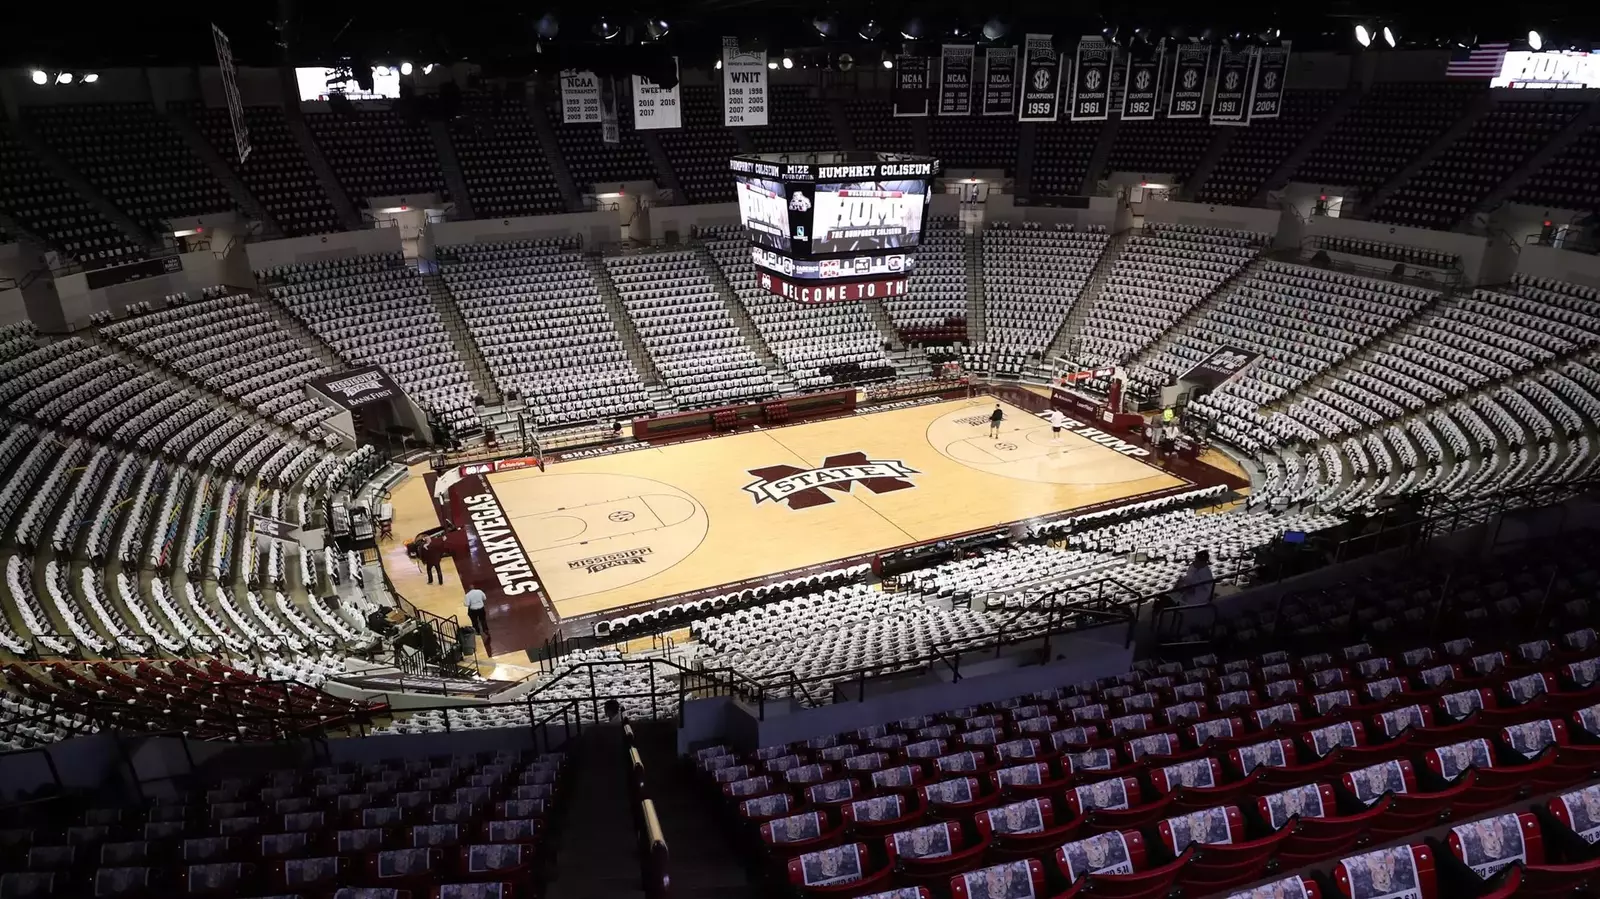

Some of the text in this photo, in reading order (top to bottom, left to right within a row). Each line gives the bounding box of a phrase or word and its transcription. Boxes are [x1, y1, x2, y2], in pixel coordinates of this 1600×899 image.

[567, 78, 594, 88] NCAA
[730, 72, 761, 83] WNIT
[901, 74, 923, 83] NCAA
[946, 74, 967, 83] NCAA
[990, 74, 1010, 83] NCAA
[1034, 69, 1050, 90] SEC
[1086, 69, 1101, 90] SEC
[1136, 70, 1150, 90] SEC
[1183, 69, 1198, 89] SEC
[1225, 71, 1239, 90] SEC
[1263, 71, 1277, 90] SEC
[638, 99, 655, 107] 2010
[1028, 102, 1050, 114] 1959
[1080, 102, 1100, 114] 1961
[1130, 102, 1150, 113] 1962
[1176, 100, 1197, 111] 1963
[1218, 101, 1236, 112] 1991
[1256, 101, 1276, 111] 2004
[730, 160, 779, 177] HUMPHREY COLISEUM
[787, 165, 809, 174] MIZE
[818, 165, 877, 179] HUMPHREY
[880, 163, 930, 176] COLISEUM
[876, 228, 902, 236] COLISEUM
[782, 282, 847, 302] WELCOME
[857, 284, 875, 298] TO
[328, 370, 383, 392] MISSISSIPPI
[1073, 427, 1150, 456] HUMP
[774, 466, 885, 493] STATE
[463, 493, 540, 596] STARKVEGAS
[568, 547, 654, 569] MISSISSIPPI
[1117, 865, 1130, 874] It's
